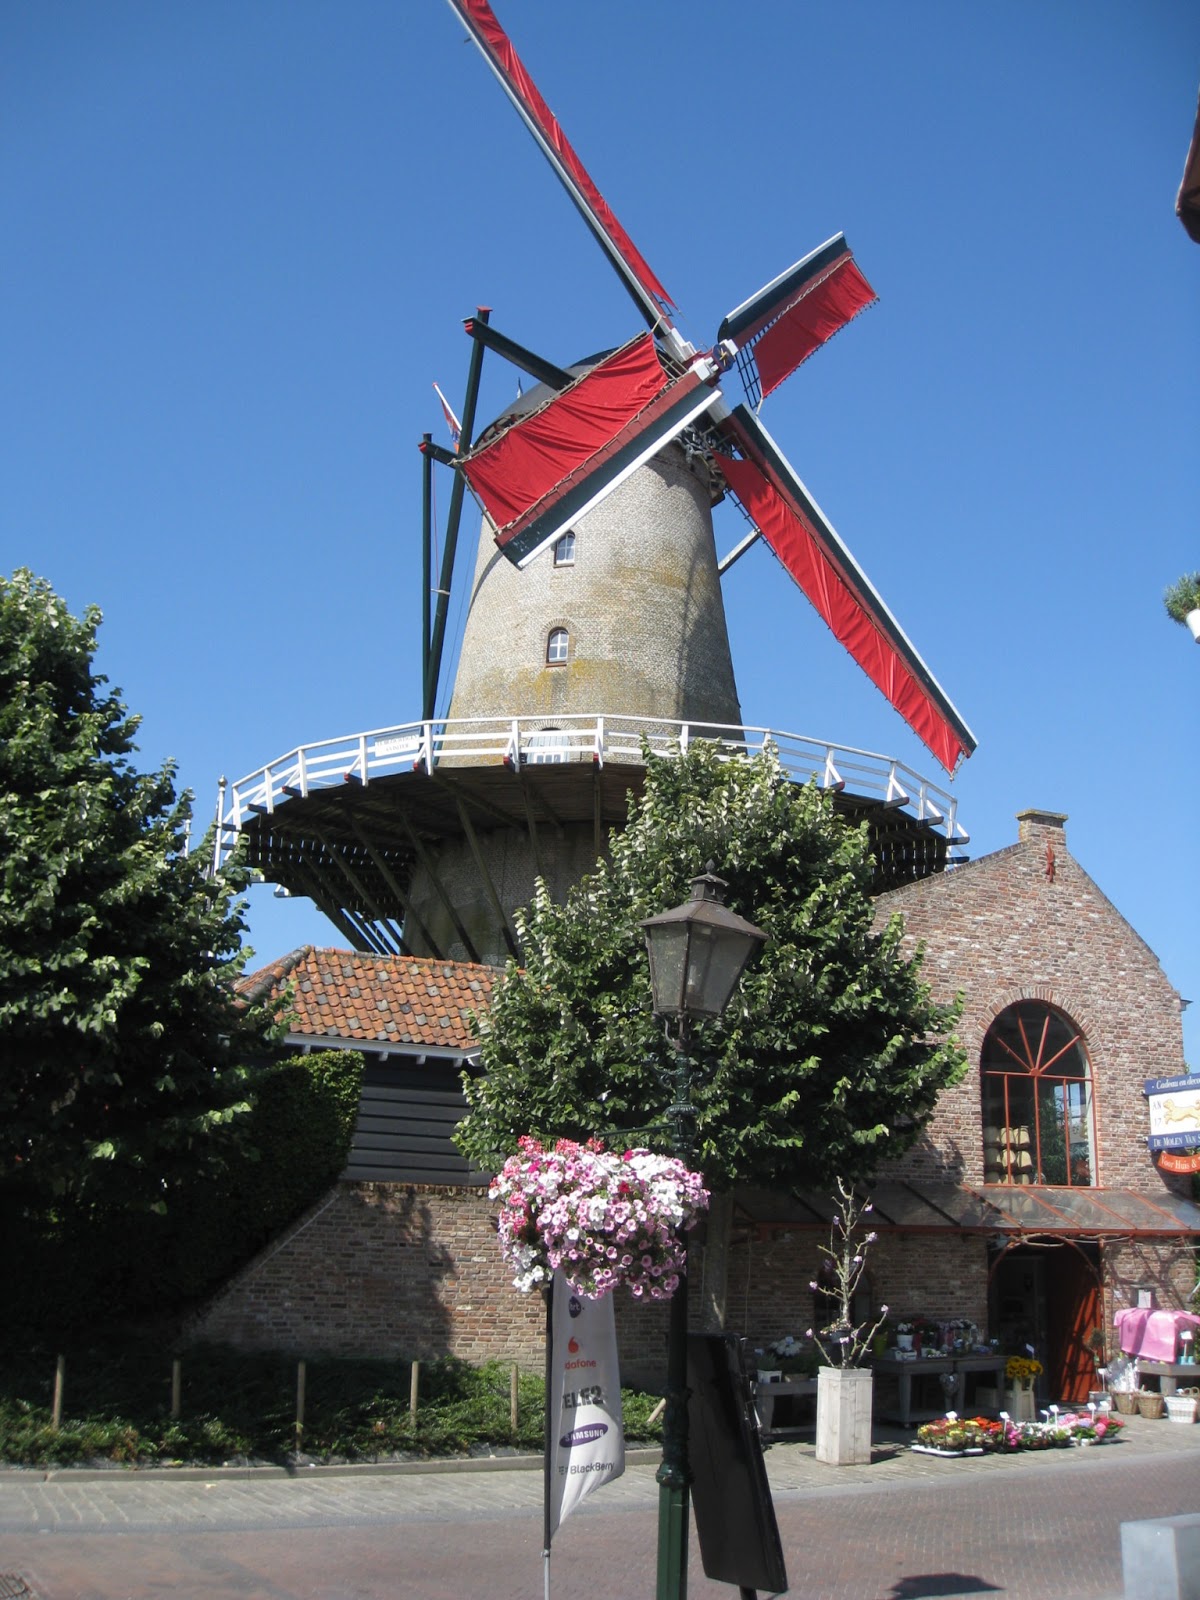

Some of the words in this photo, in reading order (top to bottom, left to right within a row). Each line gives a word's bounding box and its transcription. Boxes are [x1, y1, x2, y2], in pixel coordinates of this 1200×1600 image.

[1156, 1079, 1178, 1090] Cadeau
[564, 1359, 597, 1370] dafone
[562, 1385, 604, 1409] ELE2
[565, 1429, 604, 1442] SAMSUNG
[570, 1462, 615, 1475] BlackBerry
